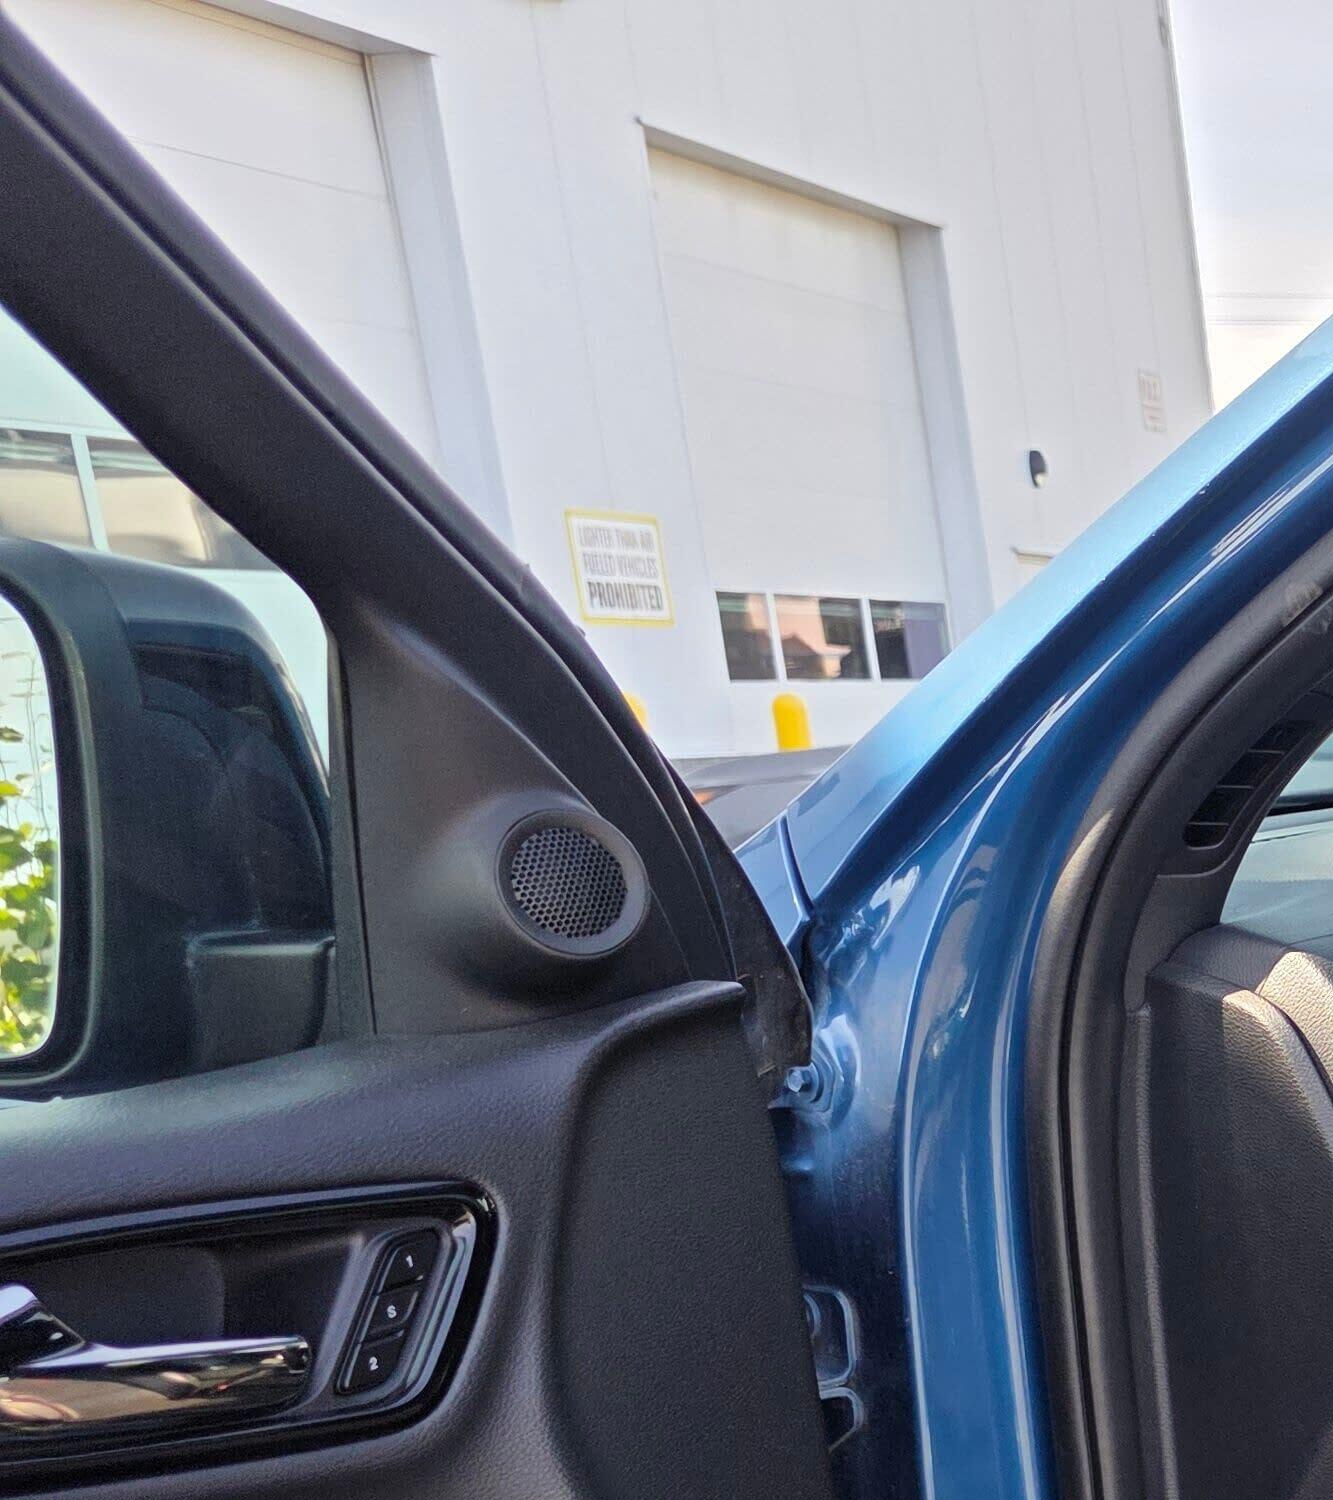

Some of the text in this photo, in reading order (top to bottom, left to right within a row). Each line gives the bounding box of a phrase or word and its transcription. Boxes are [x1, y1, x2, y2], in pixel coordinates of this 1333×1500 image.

[586, 581, 664, 611] PROHIBITED
[406, 1255, 414, 1268] 1
[386, 1305, 397, 1319] S
[368, 1356, 379, 1371] 2
